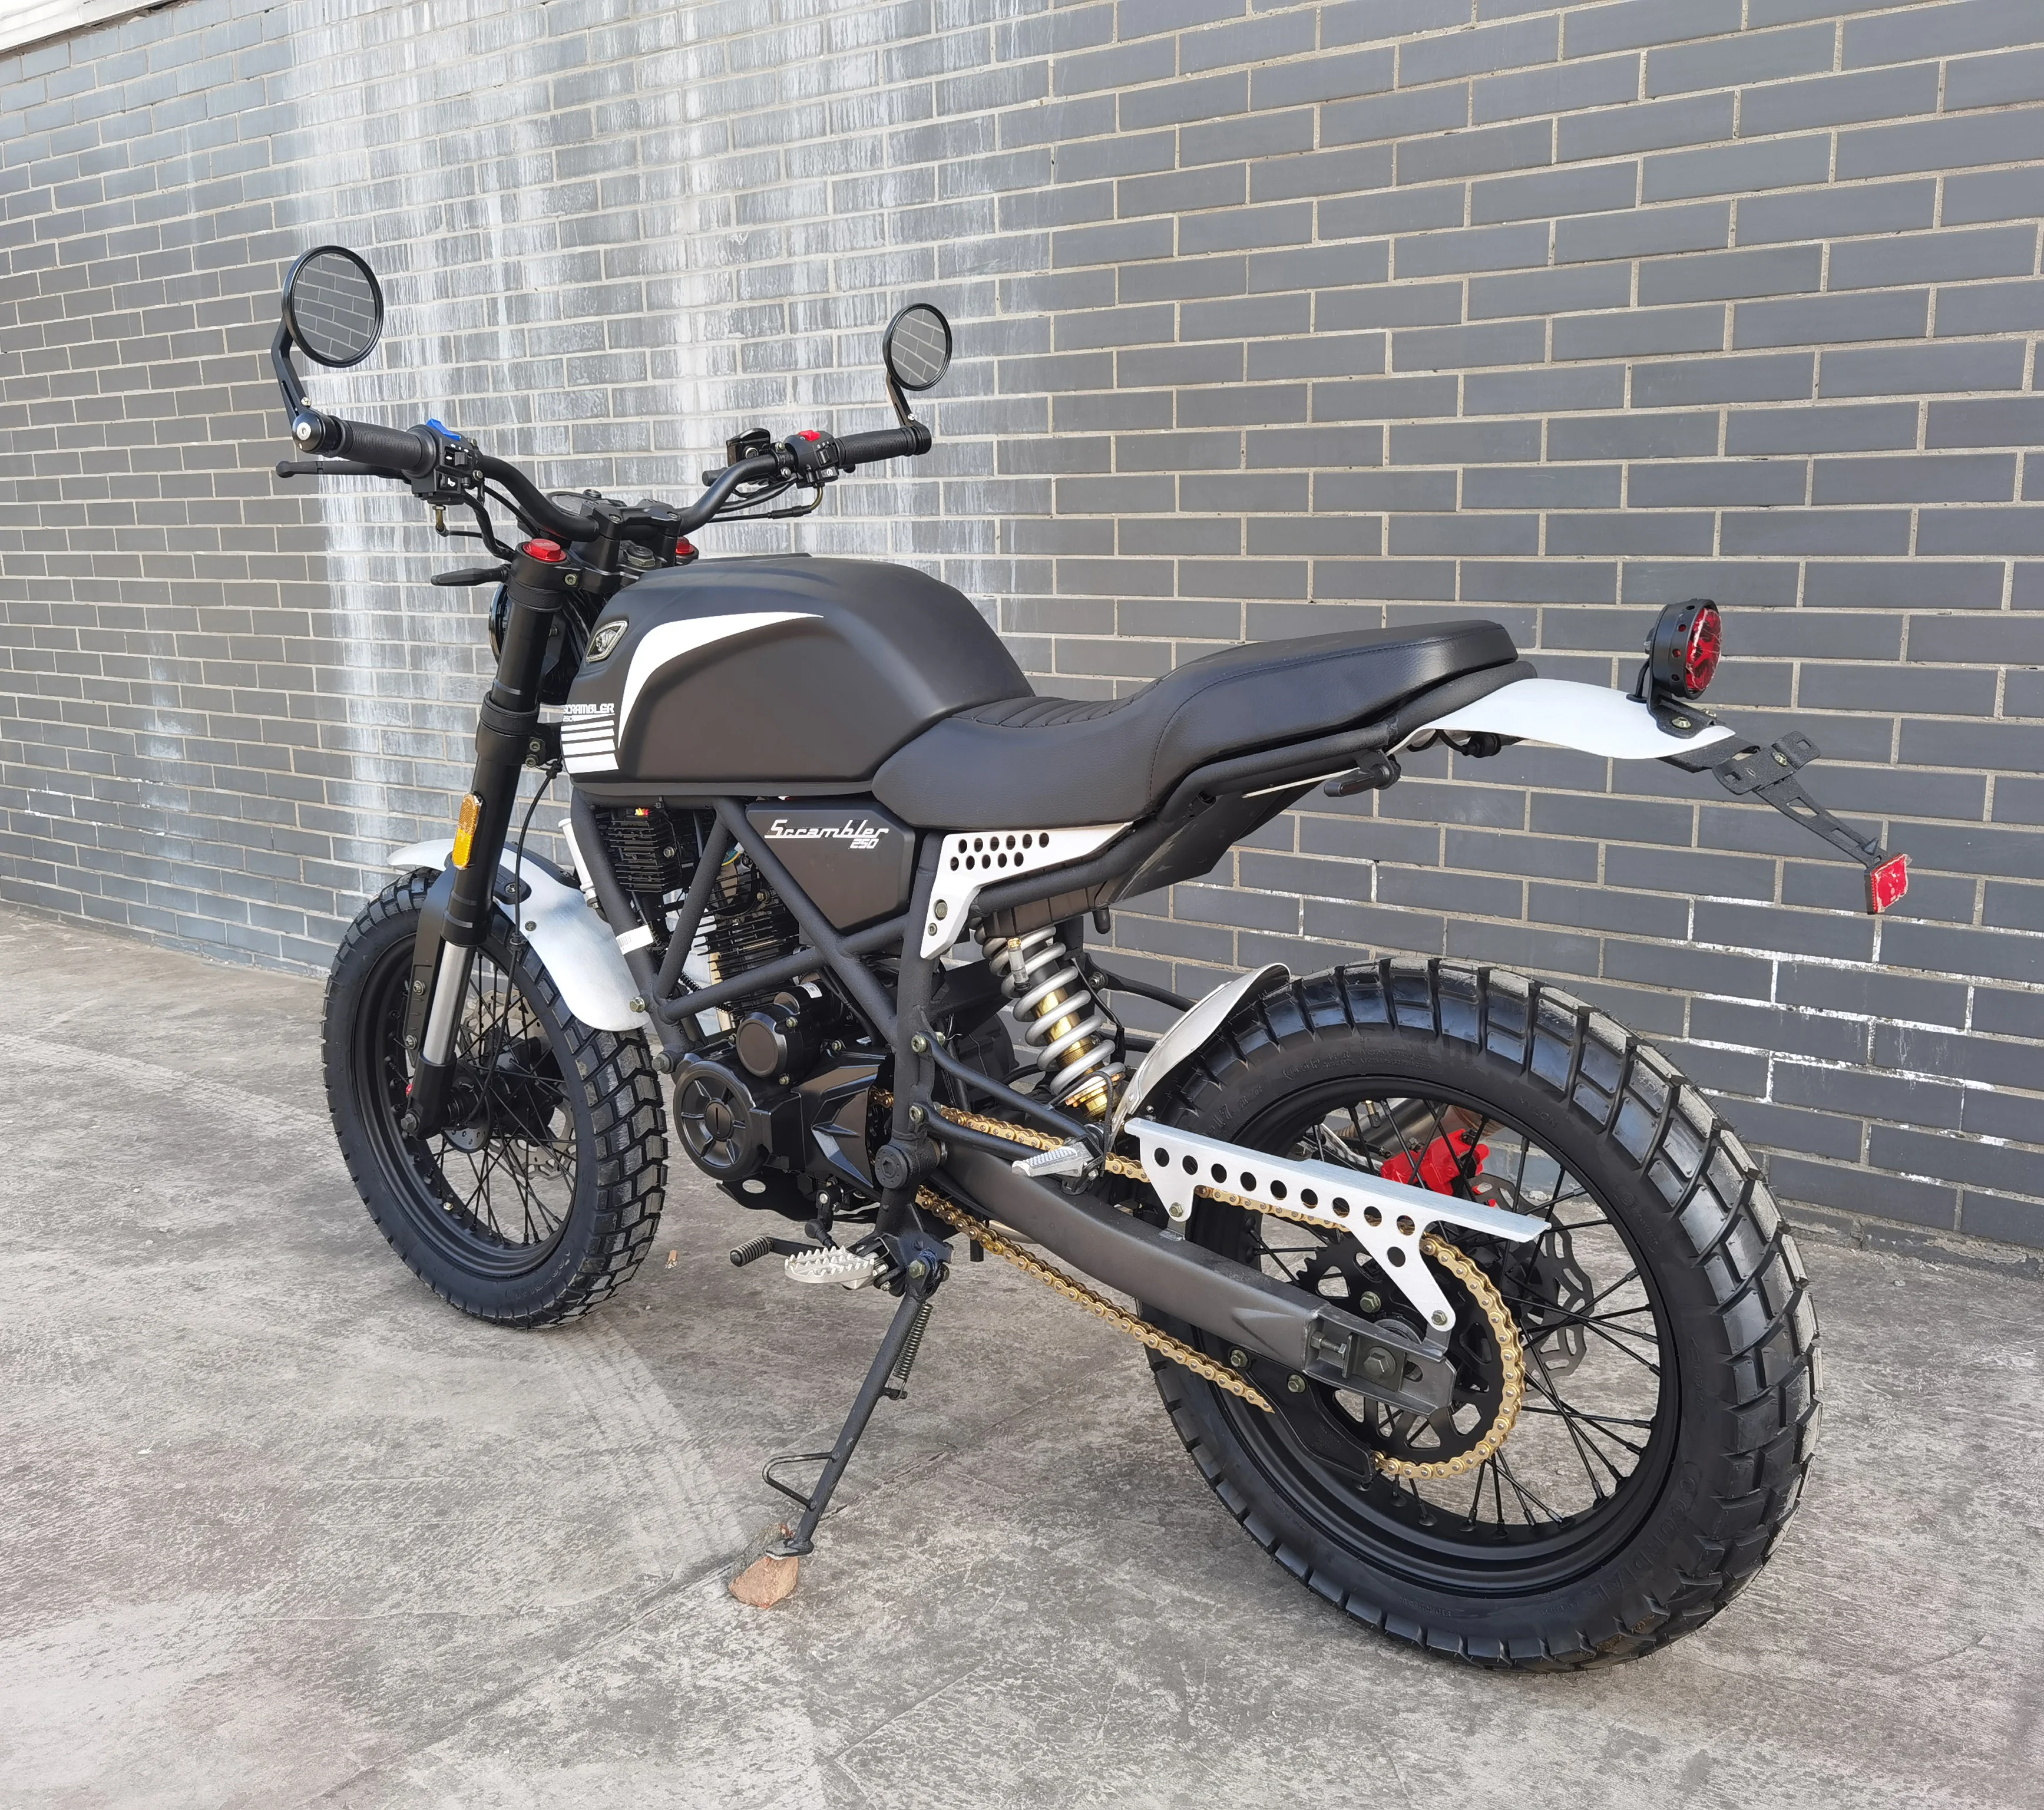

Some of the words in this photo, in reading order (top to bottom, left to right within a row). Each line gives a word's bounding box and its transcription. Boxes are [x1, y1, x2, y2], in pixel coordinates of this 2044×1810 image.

[564, 703, 614, 714] SCRAMBLER
[765, 819, 889, 838] Scrambler
[849, 838, 879, 849] 250
